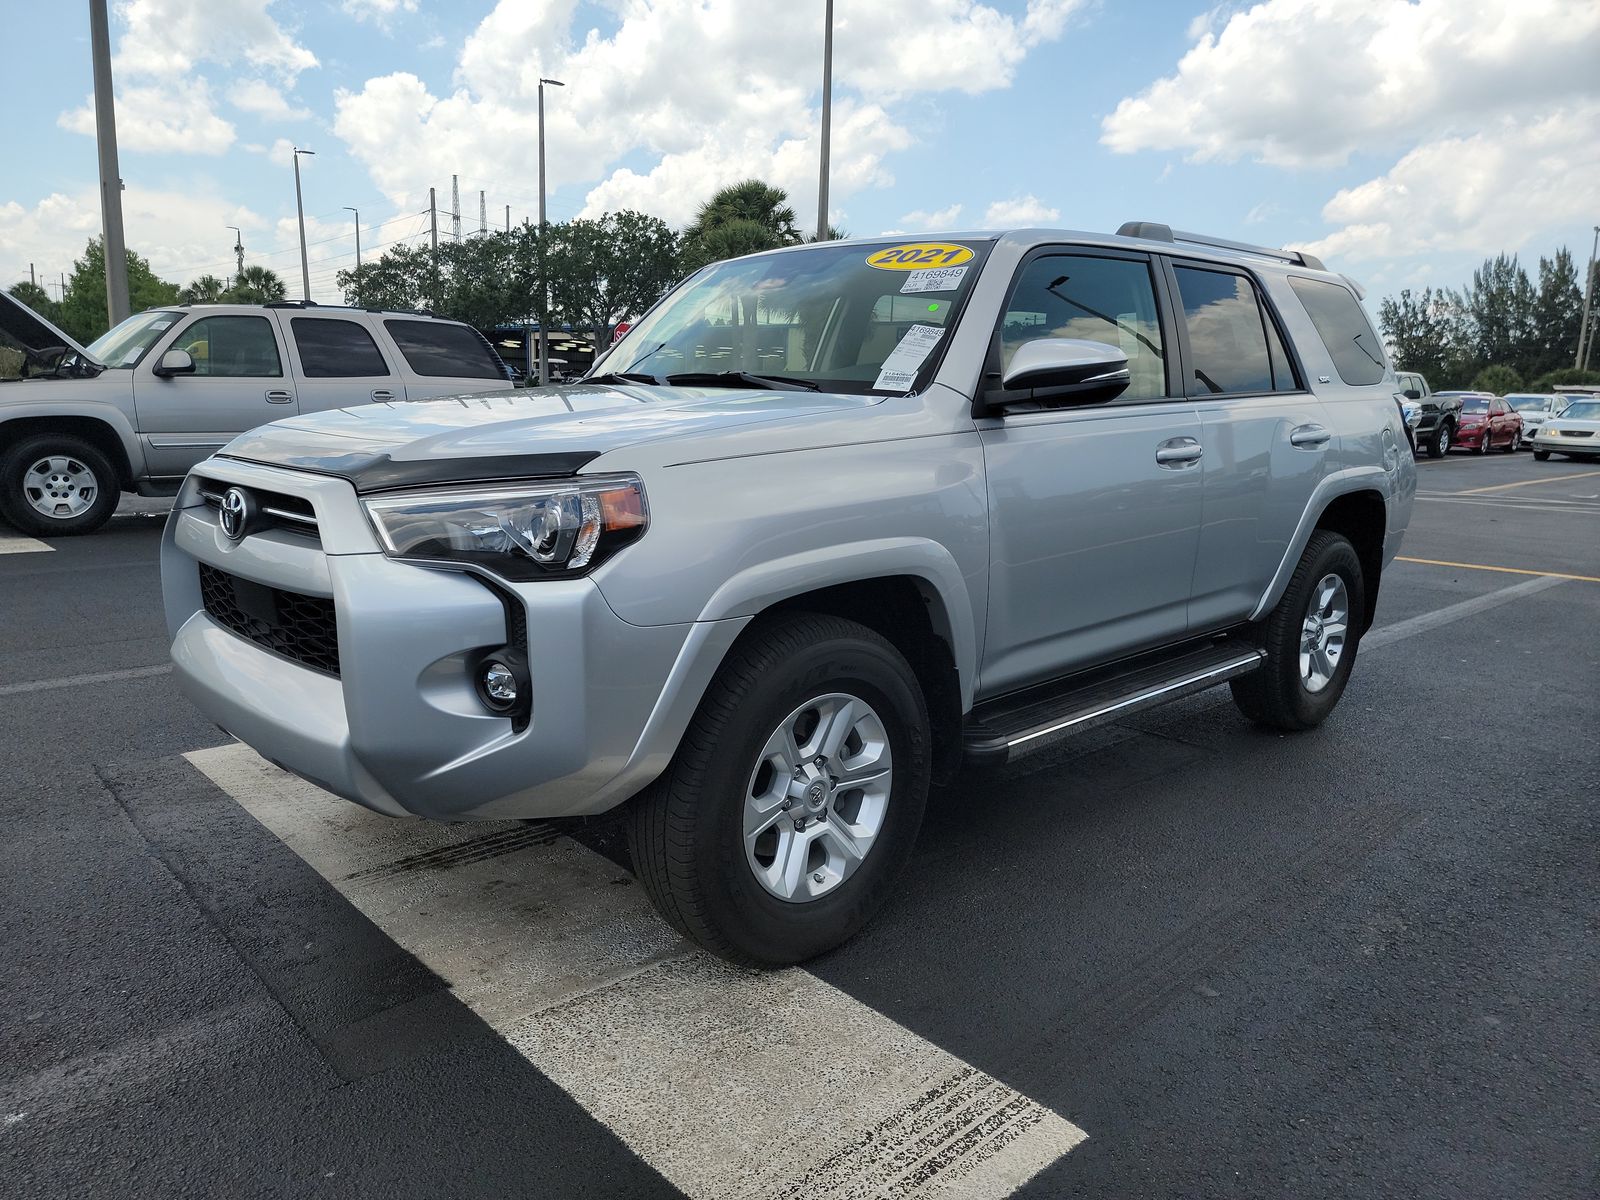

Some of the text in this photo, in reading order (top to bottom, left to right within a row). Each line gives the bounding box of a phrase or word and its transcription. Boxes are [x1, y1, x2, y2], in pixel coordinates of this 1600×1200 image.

[873, 249, 964, 264] 2021
[911, 269, 963, 280] 4169849
[911, 325, 945, 337] 4169849
